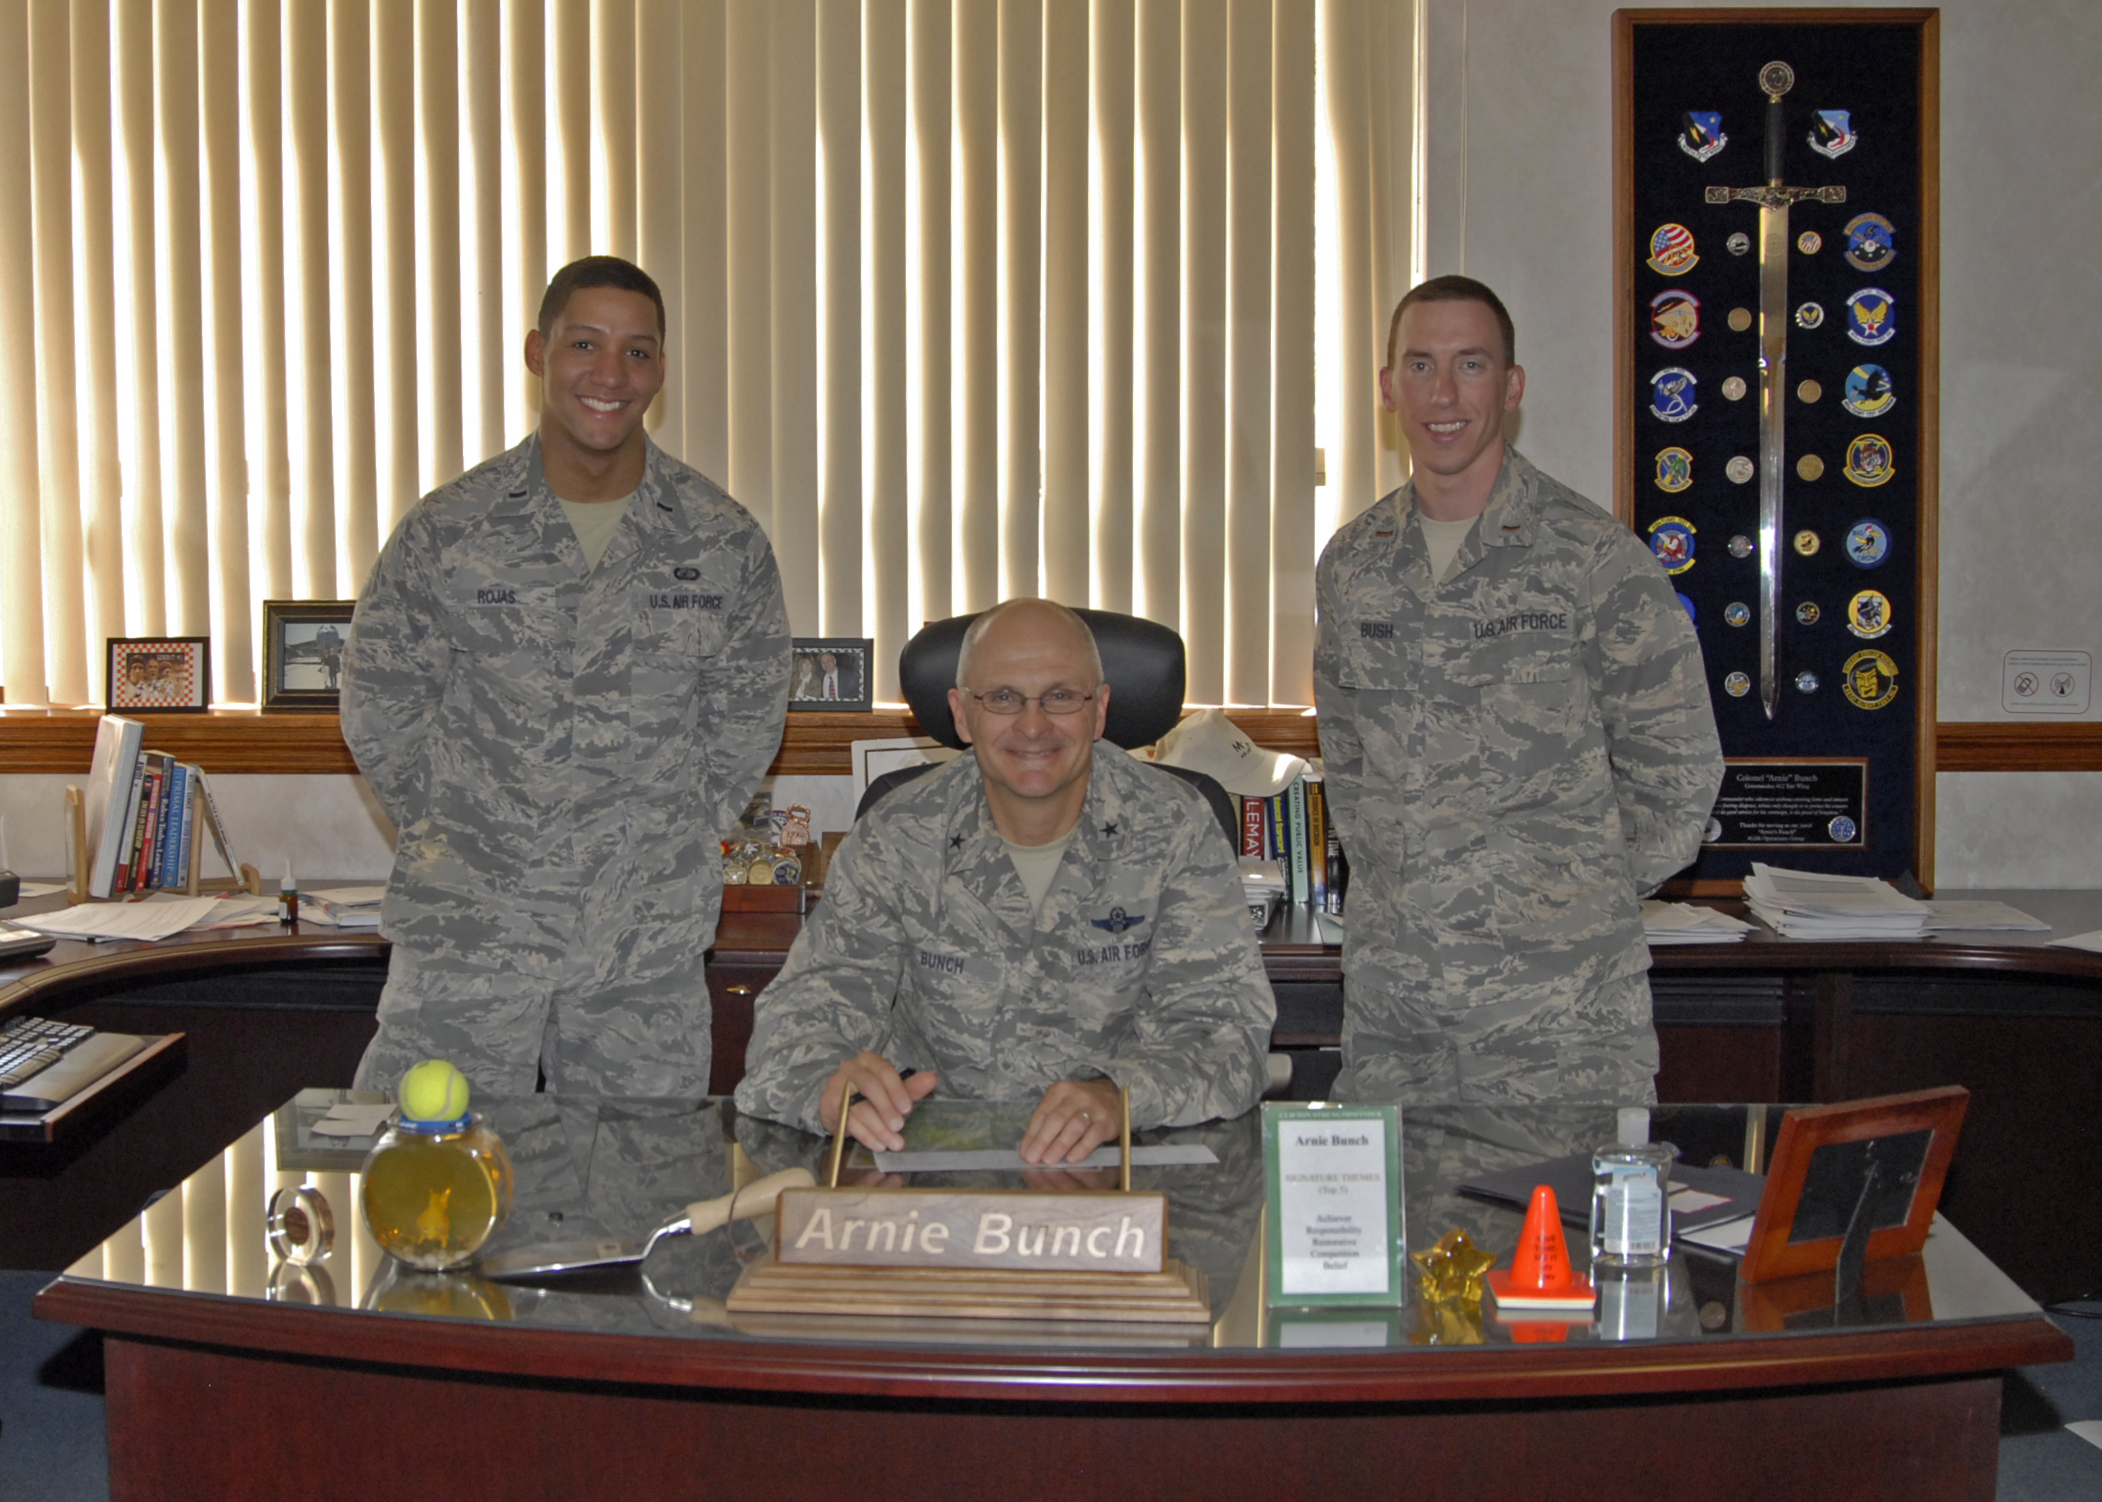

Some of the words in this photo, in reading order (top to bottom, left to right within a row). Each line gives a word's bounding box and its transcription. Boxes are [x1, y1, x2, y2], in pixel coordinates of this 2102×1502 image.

[1852, 529, 1864, 537] BIG
[1856, 554, 1878, 562] CROW
[477, 589, 516, 604] ROJAS
[649, 594, 671, 609] U.S.
[673, 594, 689, 609] AIR
[692, 594, 724, 609] FORCE
[1360, 622, 1394, 639] BUSH
[1497, 616, 1518, 635] AIR
[1521, 612, 1567, 630] FORCE
[1736, 773, 1765, 782] Colonel
[1794, 773, 1818, 782] Bunch
[171, 780, 183, 814] PRIMAL
[1292, 781, 1301, 819] CREATING
[159, 798, 169, 818] Rules
[156, 822, 167, 841] Tools
[1246, 801, 1260, 858] LEMAY
[167, 816, 180, 872] LEADERSHIP
[1328, 839, 1339, 858] TIME
[153, 848, 164, 875] Leaders
[1296, 851, 1304, 874] VALUE
[1077, 949, 1098, 966] U.S.
[1101, 945, 1121, 963] AIR
[1124, 939, 1152, 960] FOR
[920, 951, 965, 974] BUNCH
[1295, 1135, 1328, 1147] Arnie
[1332, 1135, 1369, 1147] Bunch
[1285, 1173, 1339, 1183] SIGNATURE
[1342, 1172, 1381, 1182] THEMES
[1318, 1185, 1337, 1196] (Top
[1339, 1185, 1349, 1195] 5)
[1316, 1214, 1352, 1223] Achiever
[795, 1207, 950, 1255] Arnie
[972, 1212, 1146, 1259] Bunch
[1306, 1225, 1362, 1236] Responsibility
[1312, 1238, 1357, 1247] Restorative
[1309, 1249, 1360, 1259] Competition
[1323, 1260, 1348, 1270] Belief
